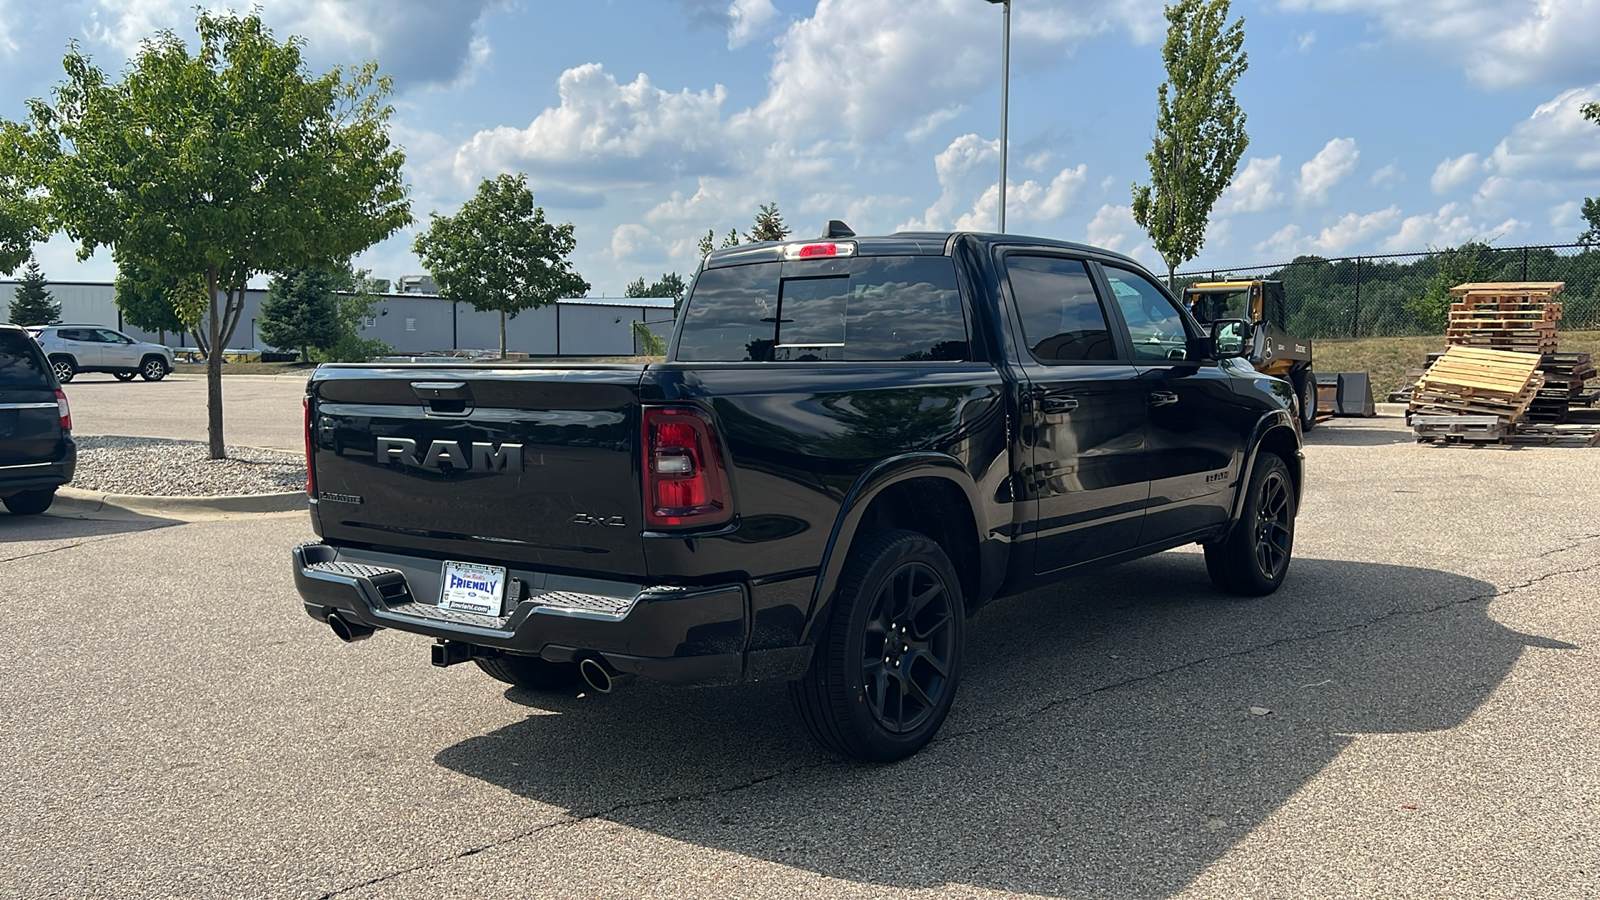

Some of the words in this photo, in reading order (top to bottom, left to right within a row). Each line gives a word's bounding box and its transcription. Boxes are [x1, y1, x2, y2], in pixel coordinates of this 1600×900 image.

[377, 436, 524, 472] RAM
[1205, 471, 1229, 483] RAM
[450, 574, 497, 595] FRIENDLY
[450, 601, 488, 613] jimriehl.com
